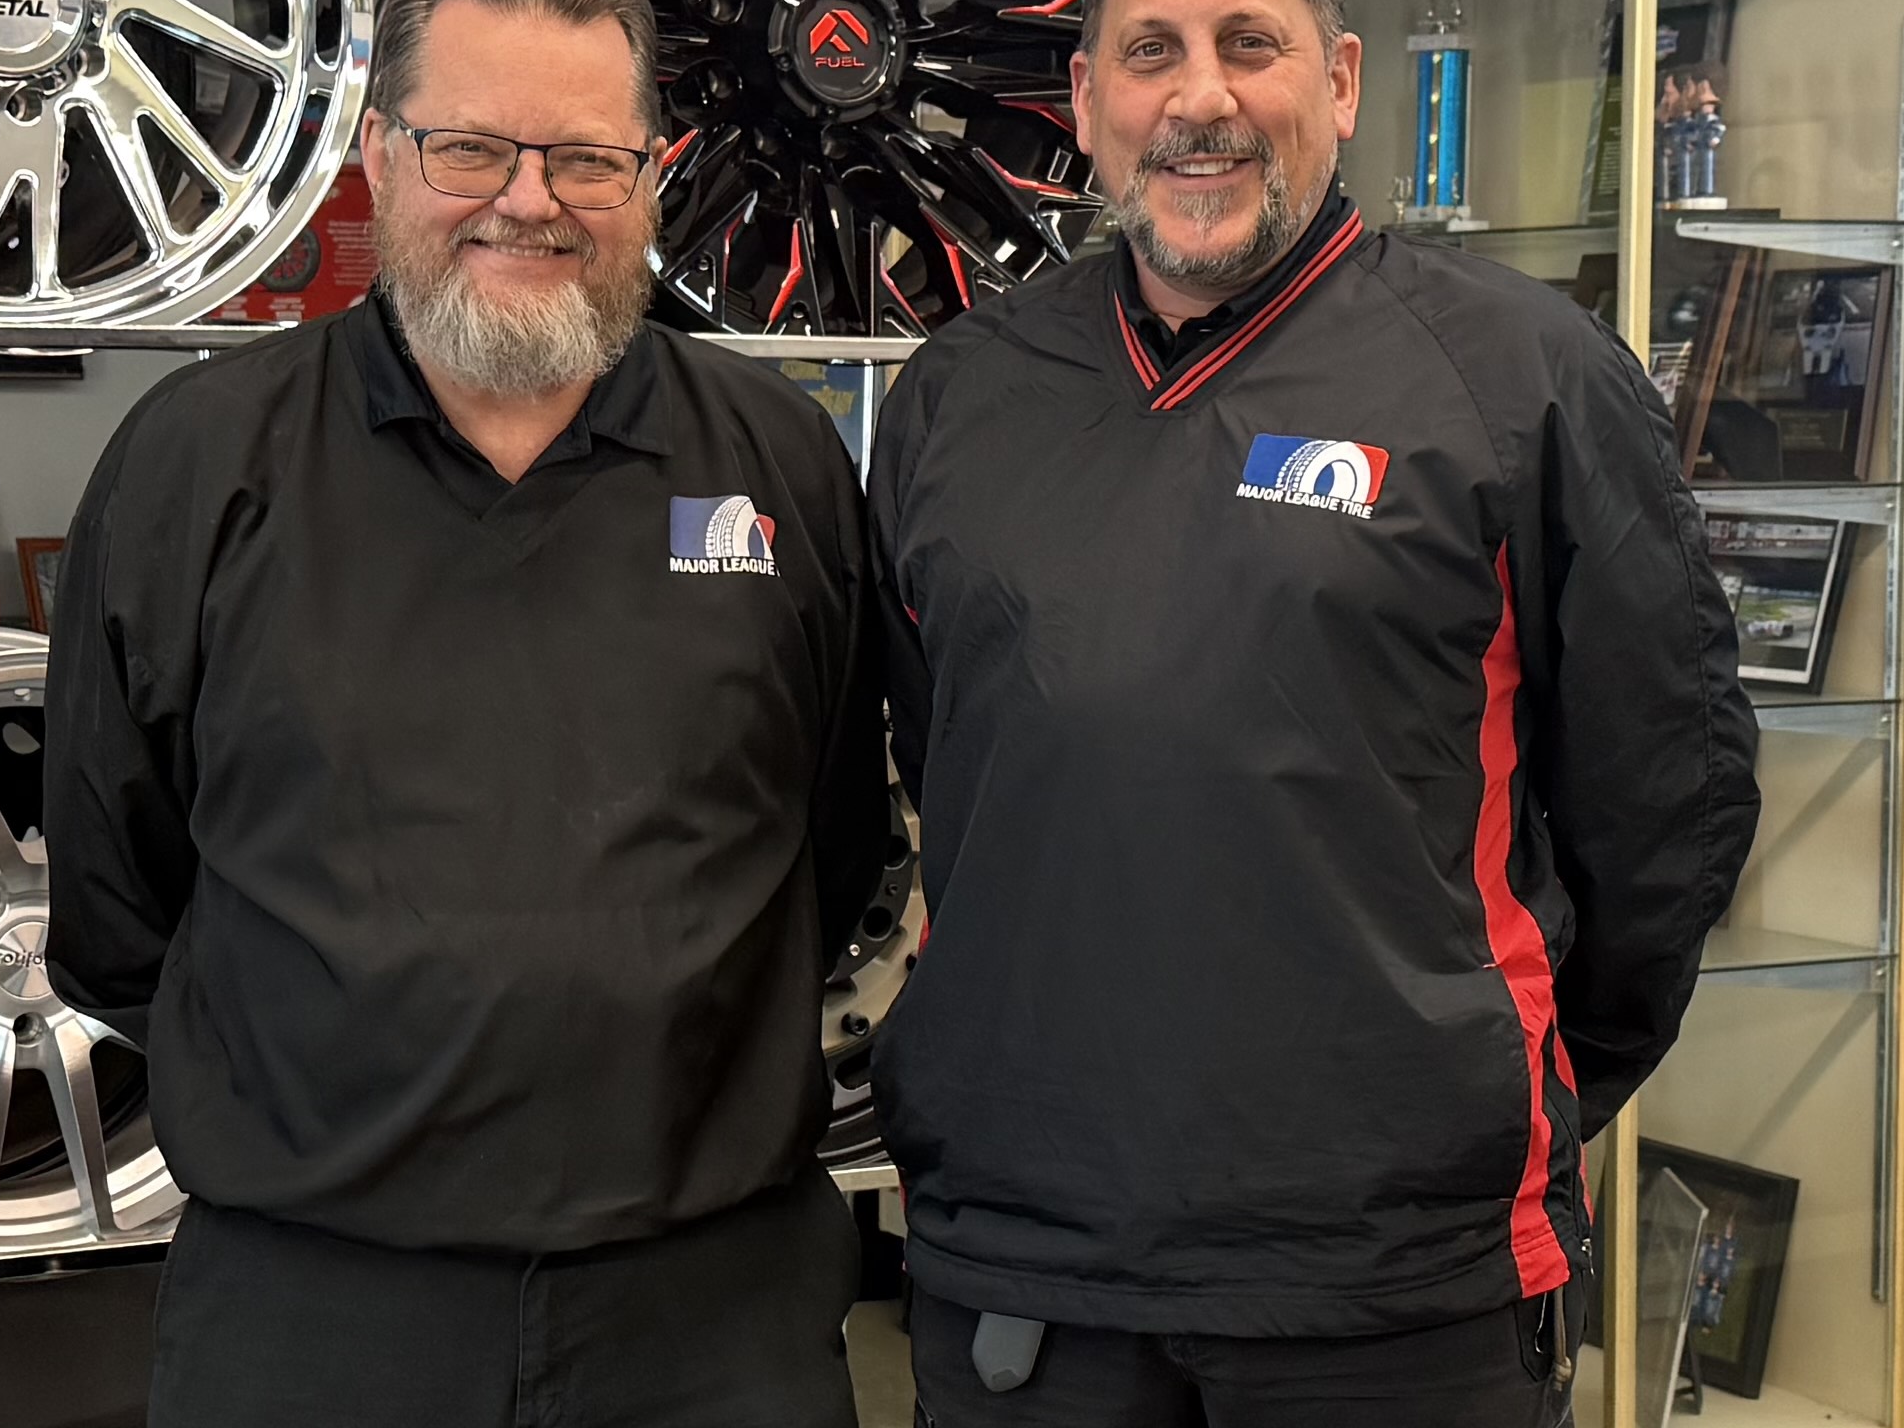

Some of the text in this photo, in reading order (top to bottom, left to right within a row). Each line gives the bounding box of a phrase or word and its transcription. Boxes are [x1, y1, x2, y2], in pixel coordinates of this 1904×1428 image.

[815, 56, 865, 69] FUEL
[1236, 482, 1374, 520] MAJOR LEAGUE TIRE
[669, 557, 776, 576] MAJOR LEAGUE
